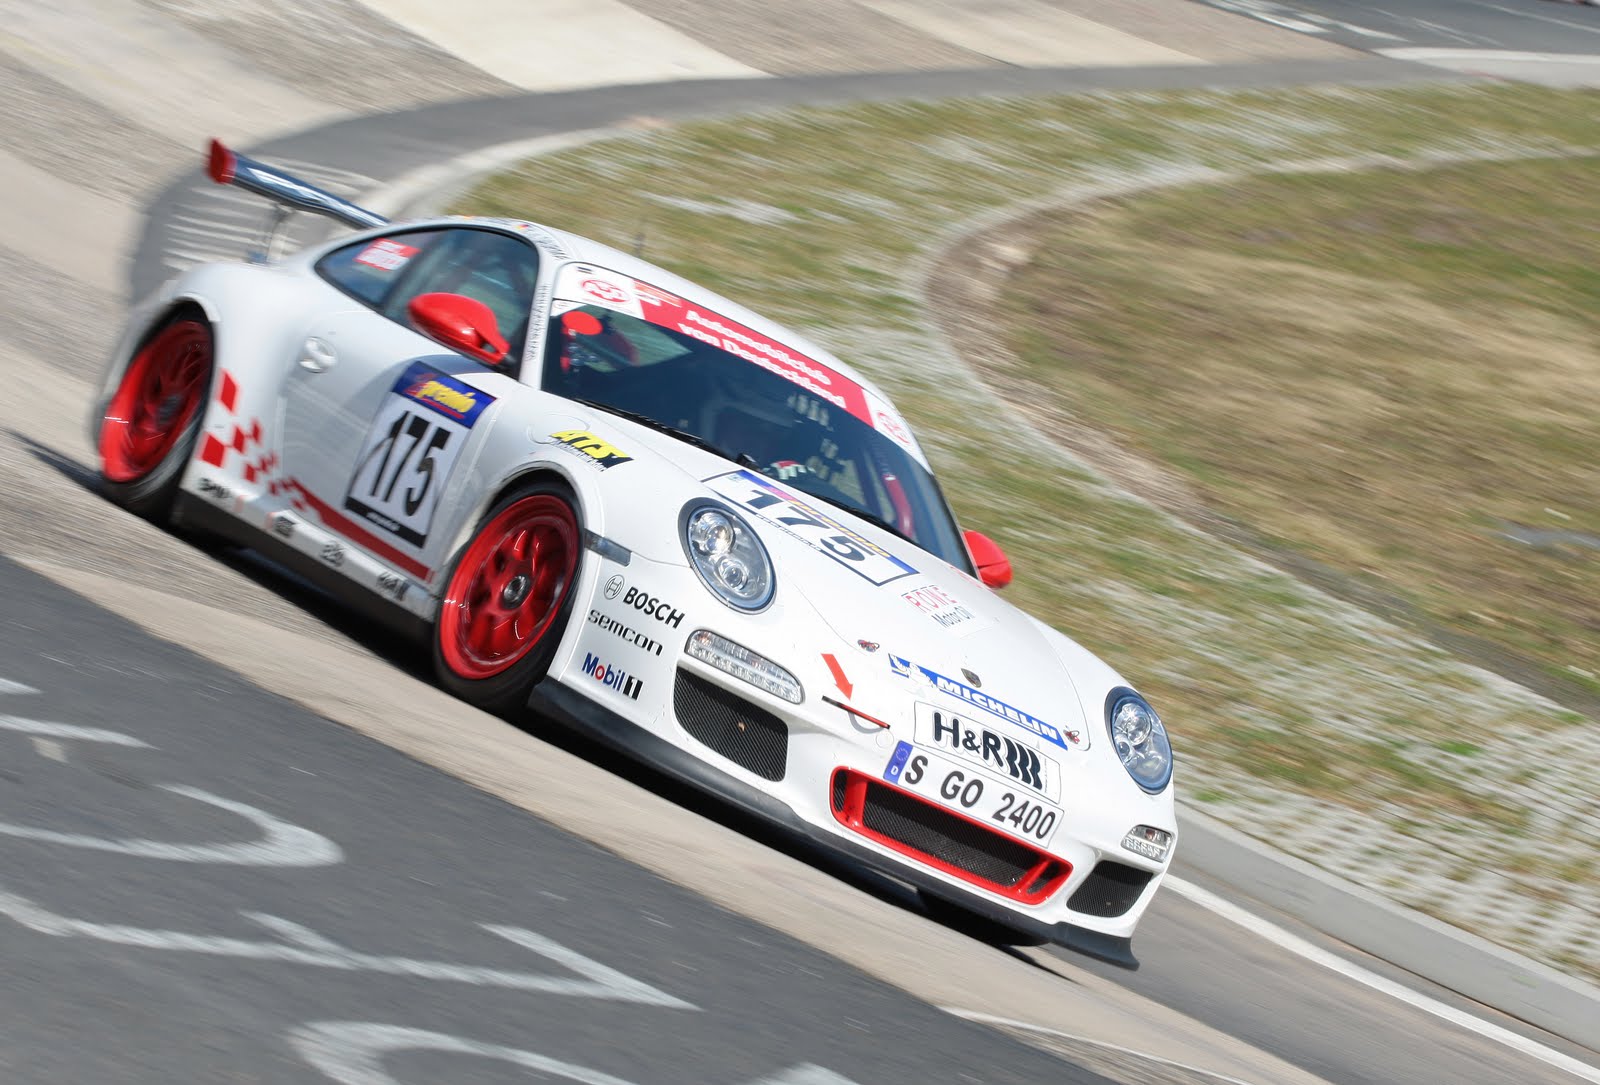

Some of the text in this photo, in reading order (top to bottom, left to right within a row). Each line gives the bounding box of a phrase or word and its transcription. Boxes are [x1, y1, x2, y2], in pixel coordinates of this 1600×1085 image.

[678, 323, 846, 408] von Deutschland
[685, 310, 832, 385] Automobilclub
[370, 410, 452, 517] 175
[550, 430, 629, 459] ATS
[744, 490, 876, 562] 175
[623, 586, 685, 629] BOSCH
[905, 586, 958, 613] ROWE
[588, 609, 663, 656] semcon
[582, 652, 626, 691] Mobil
[936, 676, 1058, 740] MICHELIN
[933, 712, 1004, 767] H&R
[890, 764, 899, 775] D
[904, 755, 1056, 840] S GO 2400
